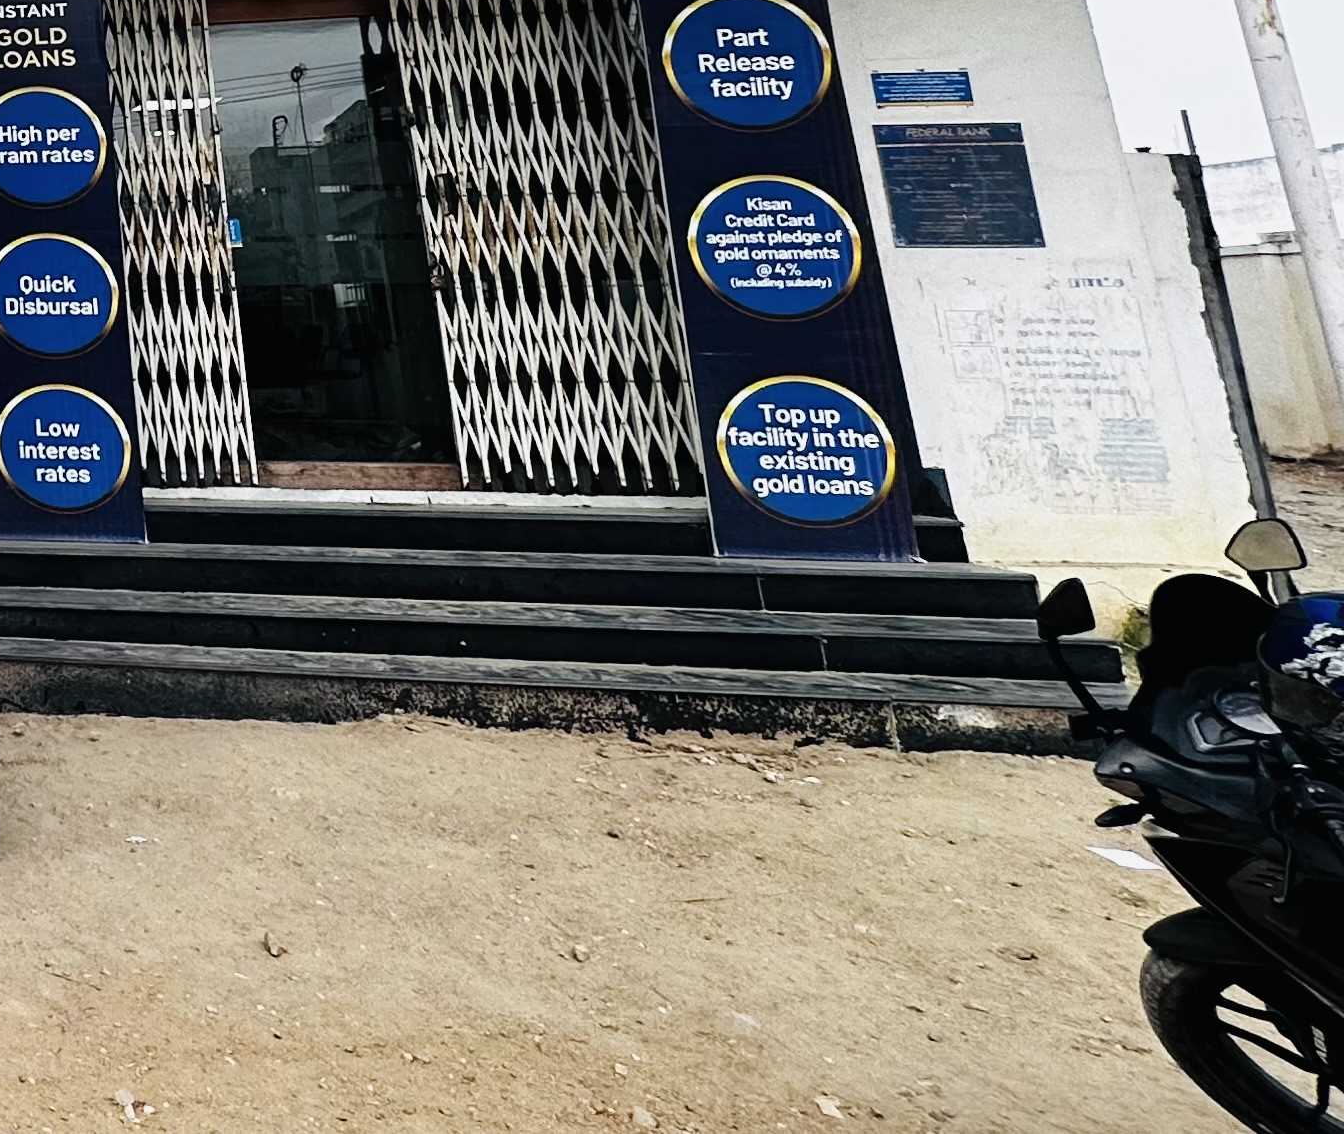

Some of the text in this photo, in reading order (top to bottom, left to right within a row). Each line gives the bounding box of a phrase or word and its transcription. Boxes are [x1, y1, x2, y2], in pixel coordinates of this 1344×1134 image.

[716, 29, 768, 48] Part
[698, 53, 795, 73] Release
[710, 77, 794, 100] facility
[45, 125, 80, 146] per
[905, 127, 991, 138] FEDERAL BANK
[42, 146, 95, 165] rates
[746, 197, 791, 212] Kisan
[724, 213, 815, 228] Credit Card
[706, 229, 842, 248] against pledge of
[714, 246, 840, 263] gold ornaments
[756, 262, 802, 278] @ 4%
[19, 275, 77, 296] Quick
[730, 276, 833, 289] (including subsidy)
[5, 296, 99, 316] Disbursal
[758, 404, 841, 426] Top up
[35, 419, 80, 438] Low
[727, 427, 880, 449] facility in the
[19, 441, 100, 461] interest
[36, 463, 91, 483] rates
[759, 452, 855, 475] existing
[753, 475, 874, 499] gold loans
